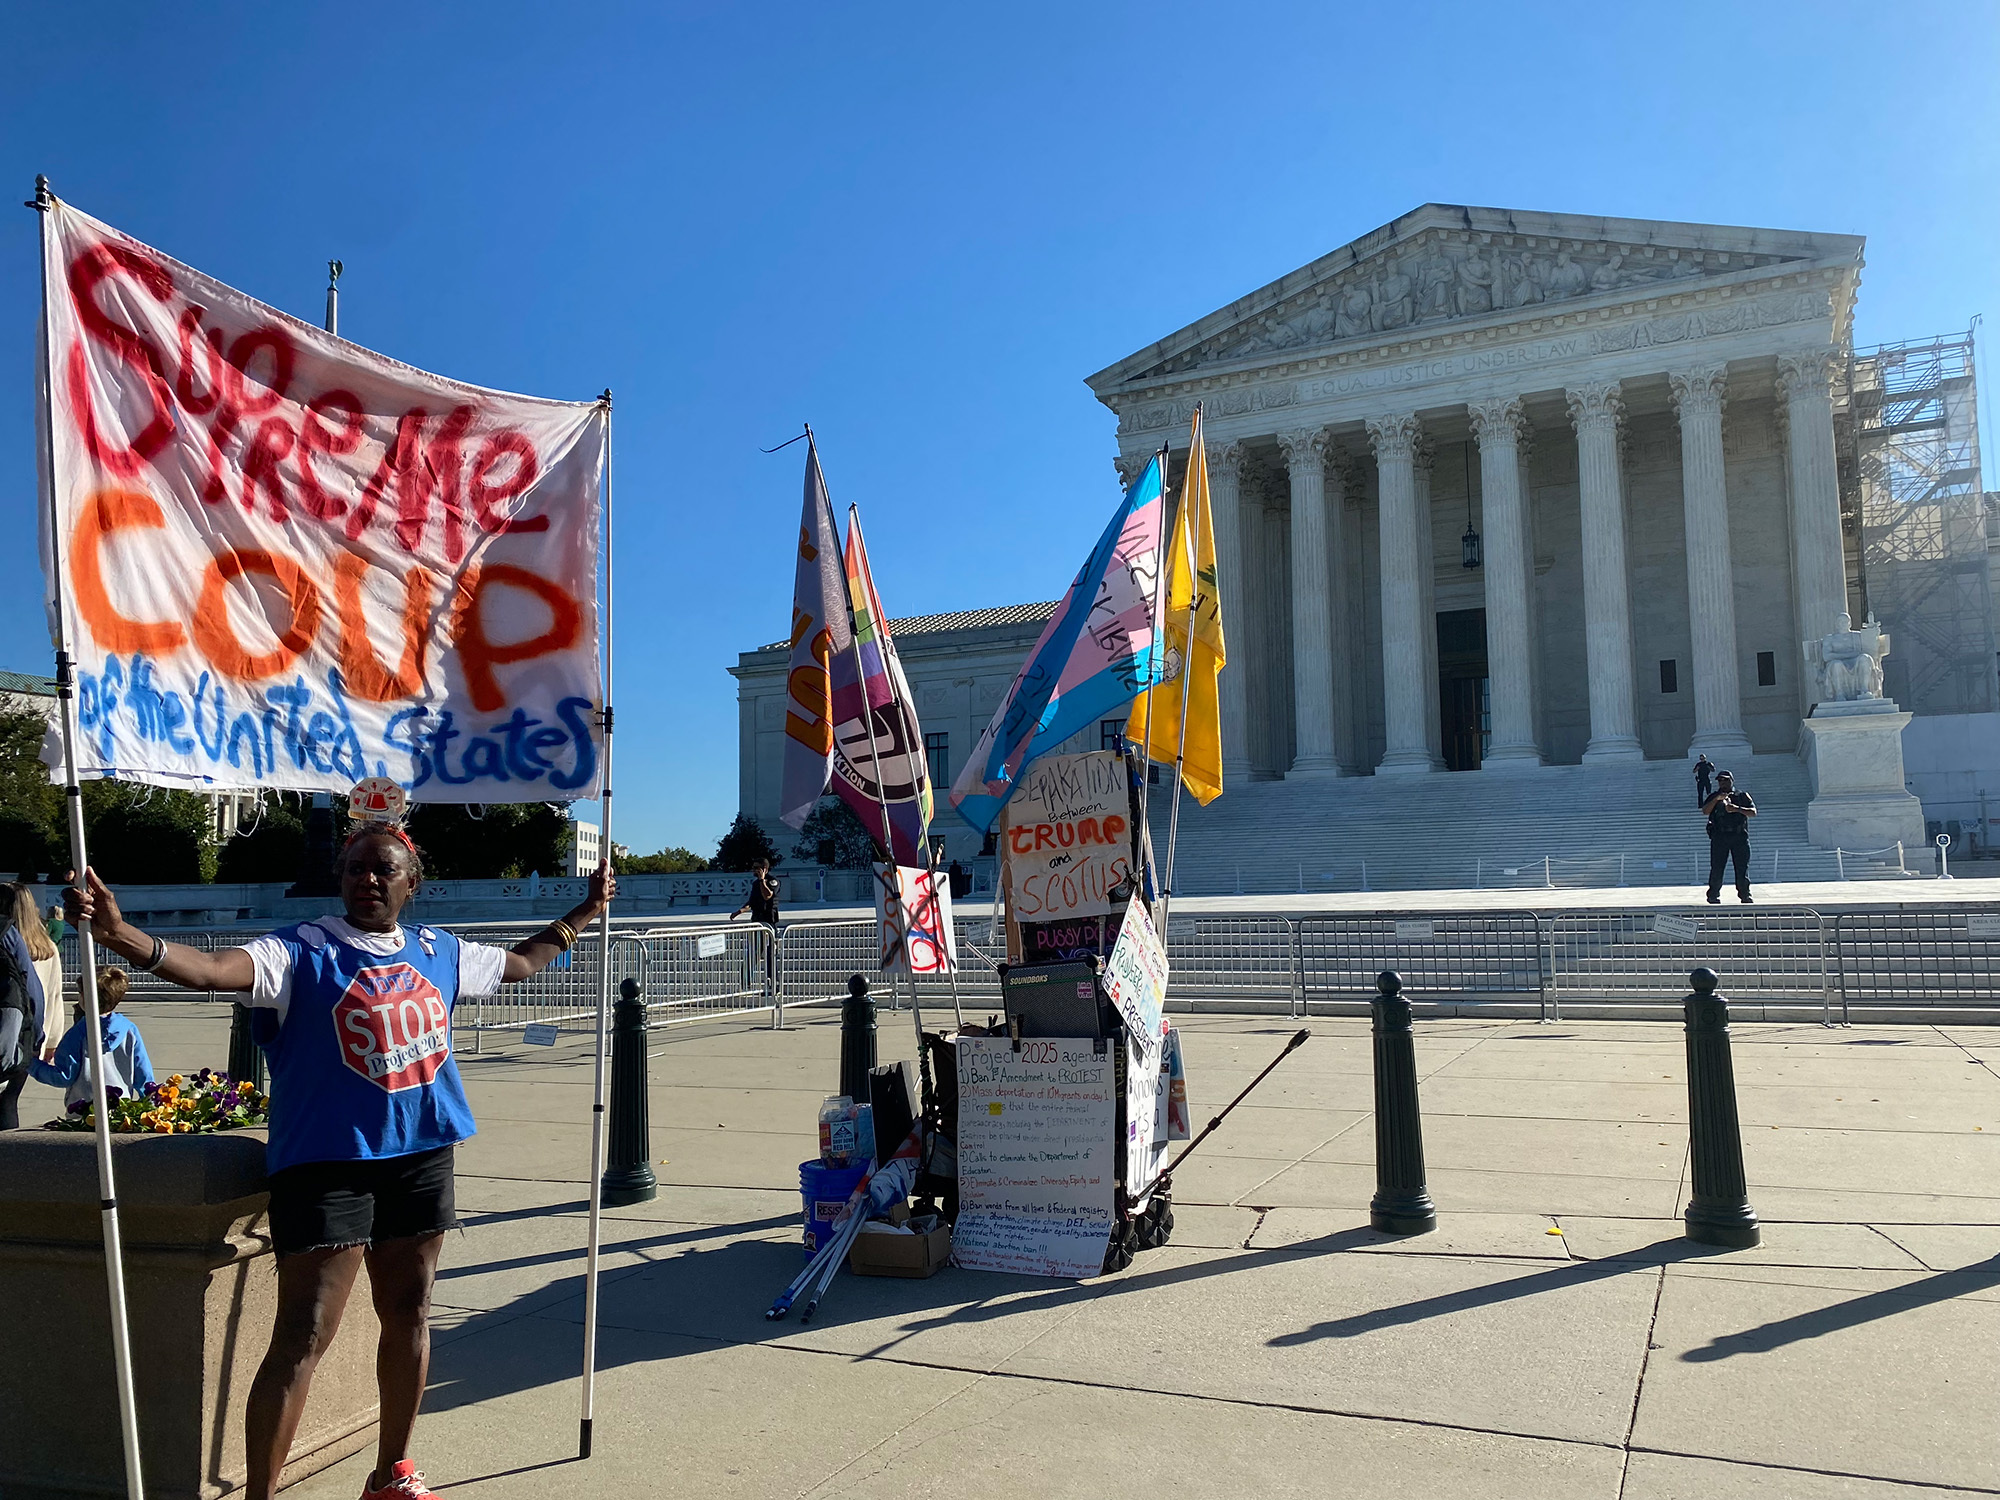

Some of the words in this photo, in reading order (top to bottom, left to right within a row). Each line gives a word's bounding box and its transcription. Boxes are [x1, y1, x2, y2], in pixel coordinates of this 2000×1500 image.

[1311, 377, 1373, 398] EQUAL
[1375, 363, 1453, 387] JUSTICE
[1463, 351, 1528, 372] UNDER
[1538, 340, 1577, 360] LAW
[70, 489, 583, 712] COUP
[78, 653, 123, 764] of
[124, 653, 196, 755] the
[1049, 853, 1072, 869] and
[1018, 856, 1129, 916] SCOTUS
[1675, 920, 1694, 928] CLOSED
[1037, 926, 1081, 949] PUSSY
[356, 971, 415, 997] VOTE
[1010, 974, 1048, 986] SOUNDBOKS
[345, 996, 447, 1057] STOP
[370, 1042, 421, 1074] Project
[959, 1042, 1014, 1071] Project
[1022, 1042, 1058, 1064] 2025
[1062, 1051, 1107, 1067] agenda
[971, 1068, 989, 1083] Ban
[1000, 1067, 1044, 1083] Amendment
[1047, 1073, 1056, 1083] to
[1058, 1068, 1105, 1084] PROTEST
[972, 1086, 993, 1097] Mass
[995, 1085, 1034, 1101] deportation
[1036, 1088, 1044, 1099] of
[1090, 1089, 1103, 1102] day
[1104, 1089, 1109, 1100] 1
[1009, 1101, 1024, 1111] that
[1028, 1102, 1039, 1111] the
[1042, 1103, 1064, 1113] entire
[989, 1131, 997, 1140] be
[969, 1151, 987, 1163] Calls
[990, 1151, 997, 1162] to
[1082, 1147, 1094, 1160] of
[1089, 1175, 1100, 1184] and
[969, 1200, 983, 1210] Ban
[984, 1201, 1003, 1210] words
[1005, 1200, 1020, 1211] from
[1022, 1202, 1030, 1212] all
[1079, 1206, 1109, 1219] registry
[961, 1237, 989, 1247] National
[992, 1241, 1020, 1252] abortion
